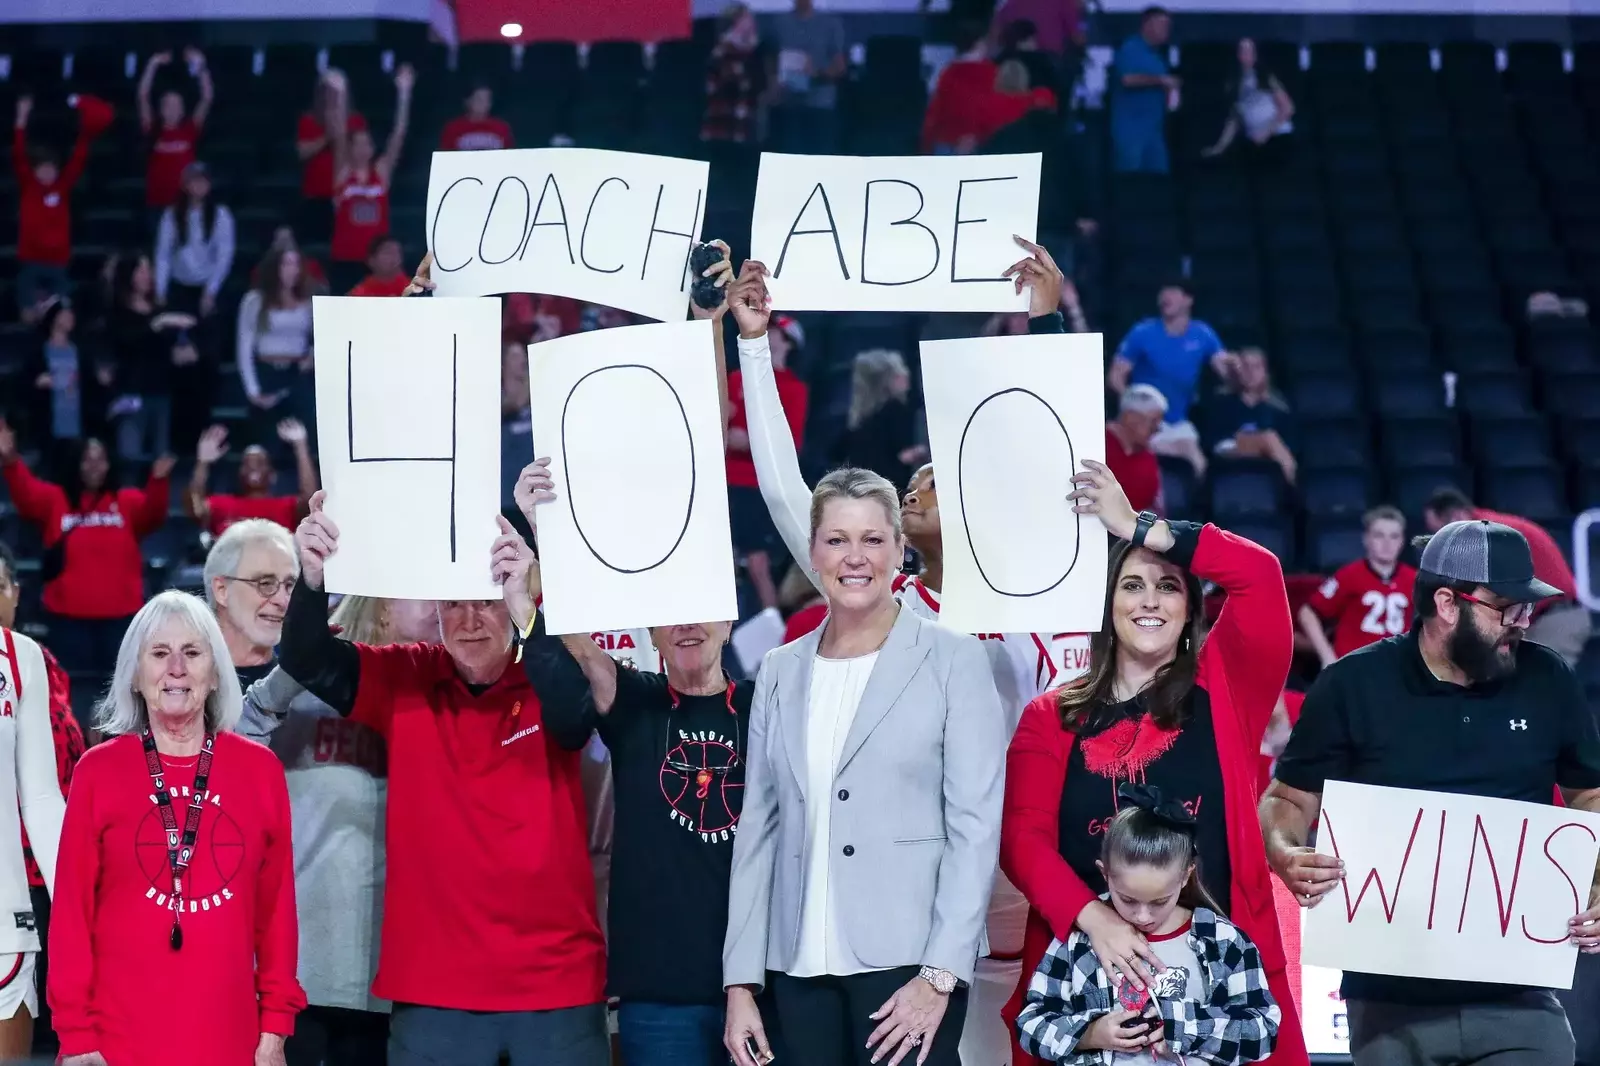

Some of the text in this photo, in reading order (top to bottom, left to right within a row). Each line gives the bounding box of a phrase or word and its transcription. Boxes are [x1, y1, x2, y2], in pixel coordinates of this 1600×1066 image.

[432, 173, 702, 292] COACH
[773, 176, 1018, 286] ABE
[347, 333, 457, 563] 4
[561, 363, 696, 574] 0
[958, 386, 1080, 597] 0
[1360, 590, 1409, 635] 26
[670, 808, 737, 844] BULDOGS
[1322, 807, 1597, 944] WINS
